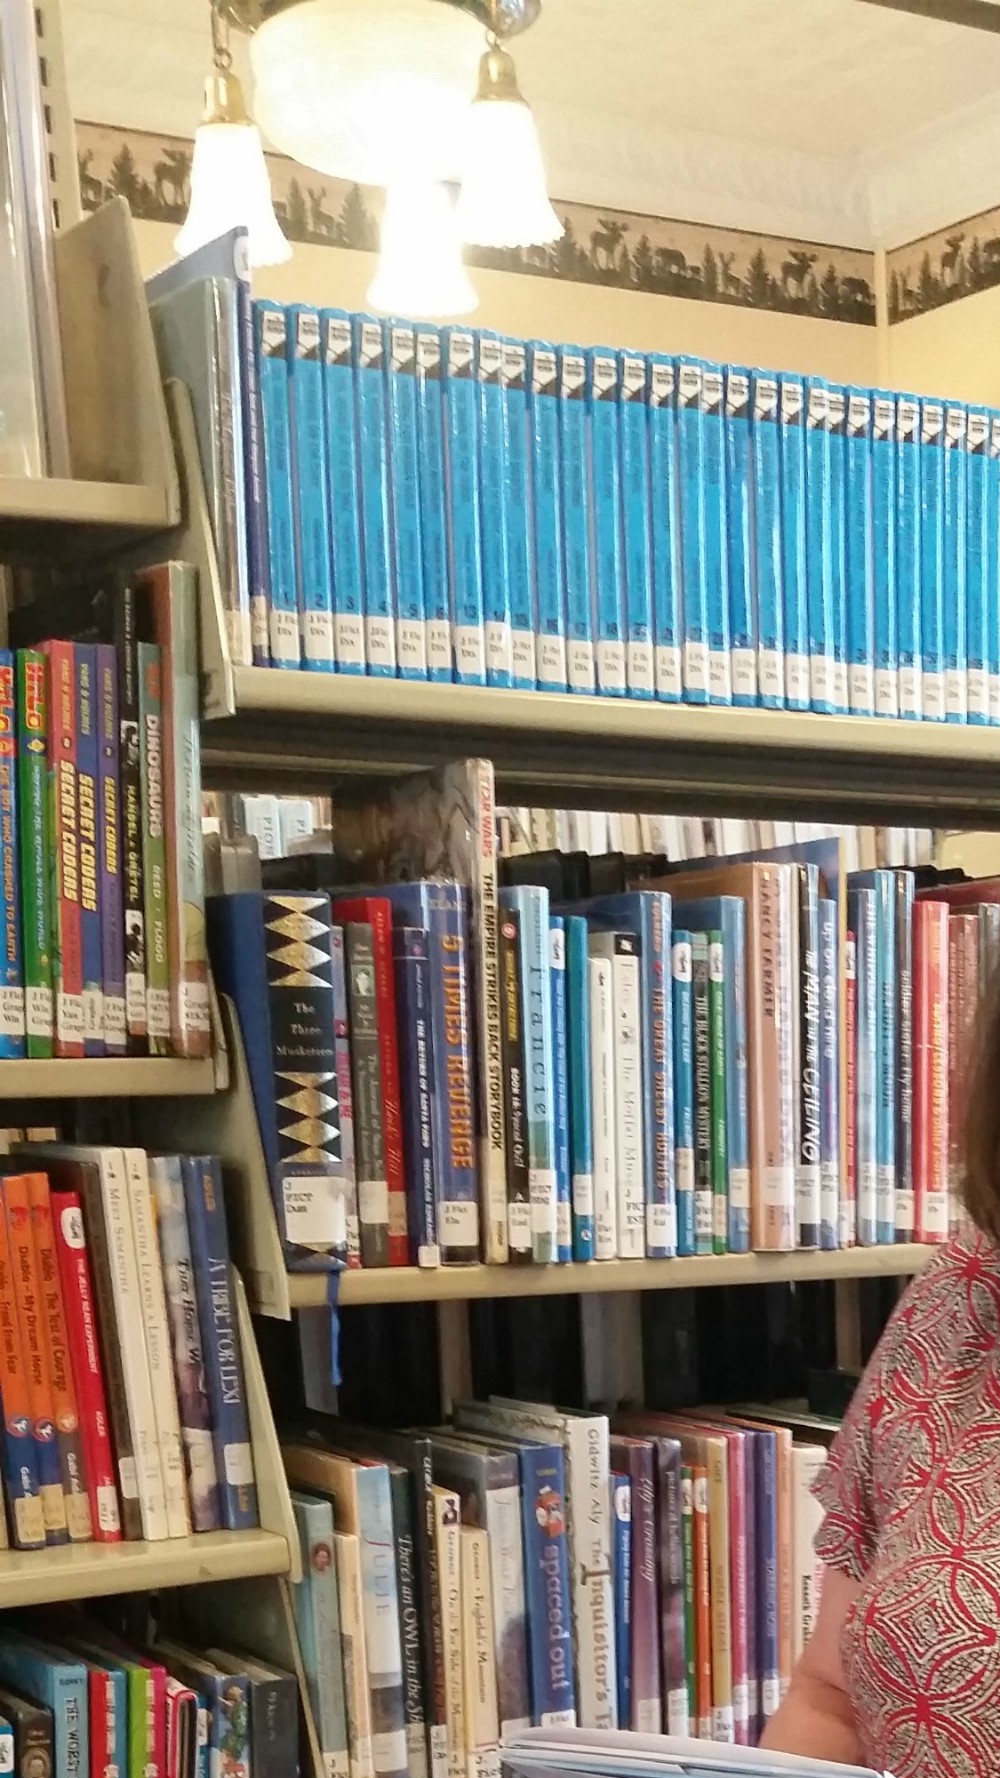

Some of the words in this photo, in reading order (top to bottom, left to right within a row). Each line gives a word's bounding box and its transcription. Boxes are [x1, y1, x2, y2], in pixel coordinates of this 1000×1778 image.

[145, 714, 164, 838] DINOSAURS
[78, 773, 95, 841] SECRET
[481, 817, 495, 858] WARS
[80, 842, 98, 912] CODERS
[482, 873, 494, 901] THE
[484, 904, 498, 958] EMPIRE
[293, 1003, 315, 1014] The
[486, 962, 499, 1020] STRIKES
[802, 971, 820, 1022] MAN
[488, 1024, 501, 1062] BACK
[528, 963, 549, 1116] Francie
[489, 1065, 505, 1150] STORYBOOK
[801, 1067, 821, 1162] CEILING
[219, 1366, 241, 1404] LEXI
[587, 1498, 603, 1525] Aly
[539, 1544, 567, 1640] spaced
[403, 1607, 419, 1656] OWL
[549, 1647, 570, 1690] out
